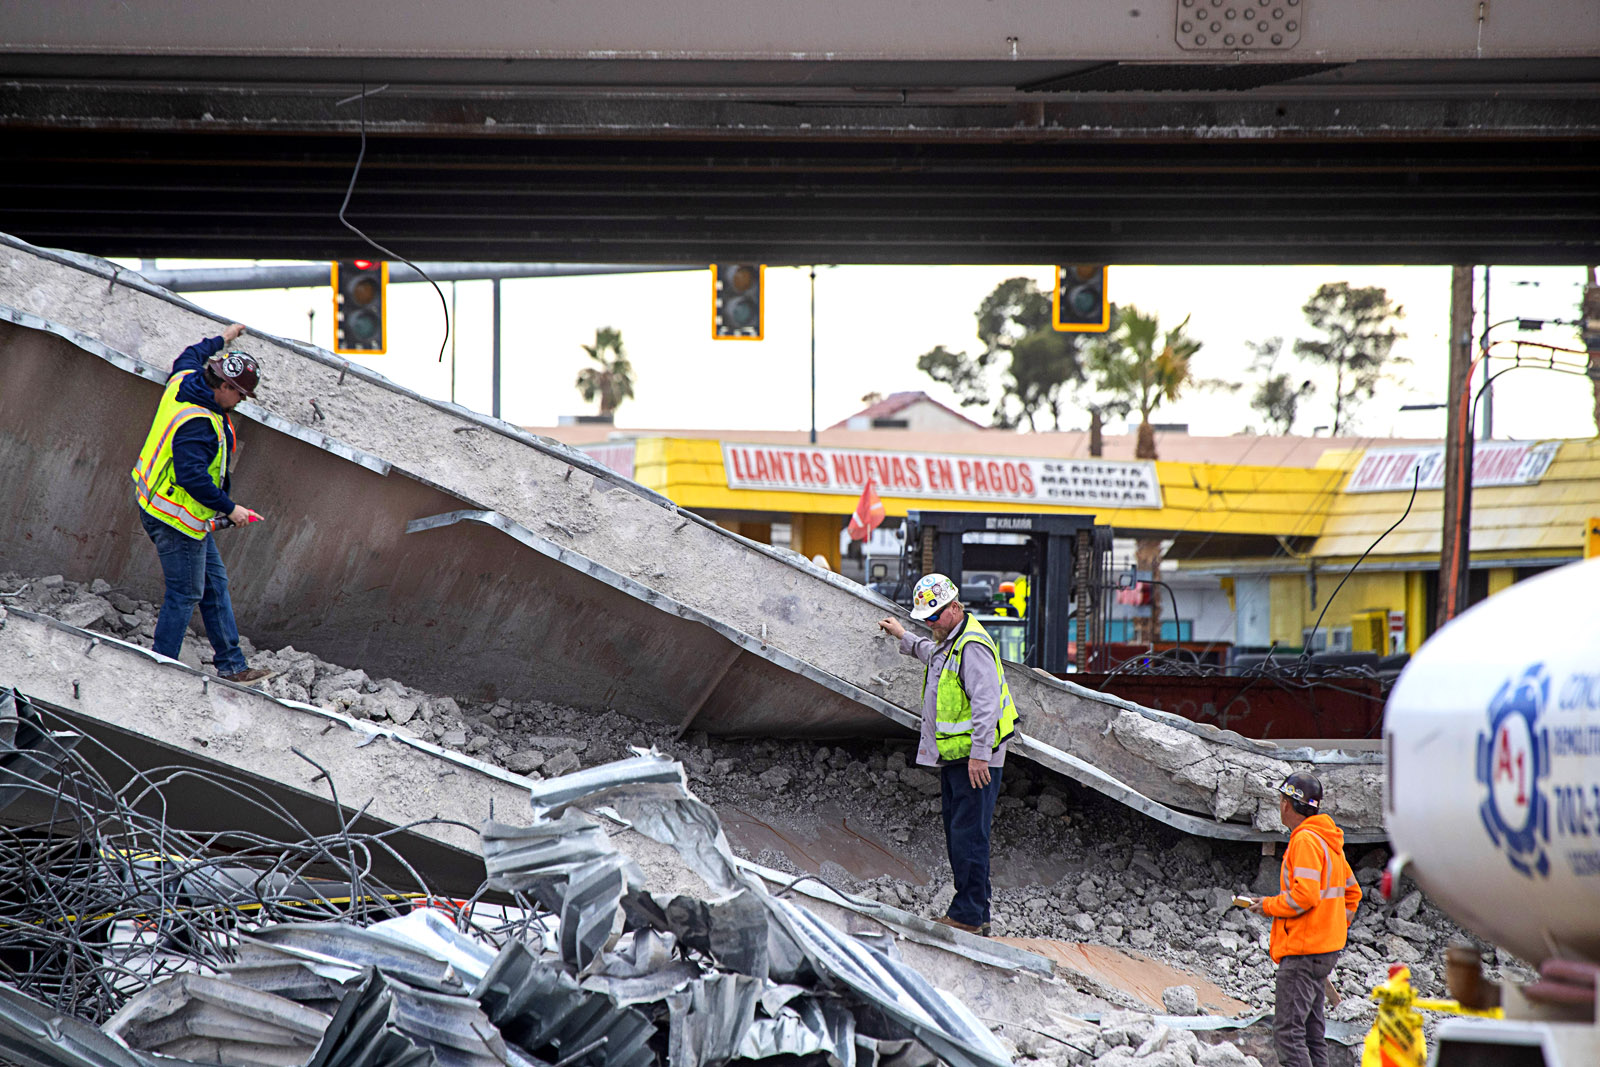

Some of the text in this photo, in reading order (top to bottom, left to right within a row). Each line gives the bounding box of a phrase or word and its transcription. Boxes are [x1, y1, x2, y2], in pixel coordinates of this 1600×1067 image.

[731, 449, 1036, 495] LLANTAS NUEVAS EN PAGOS
[997, 518, 1032, 530] KALMAR
